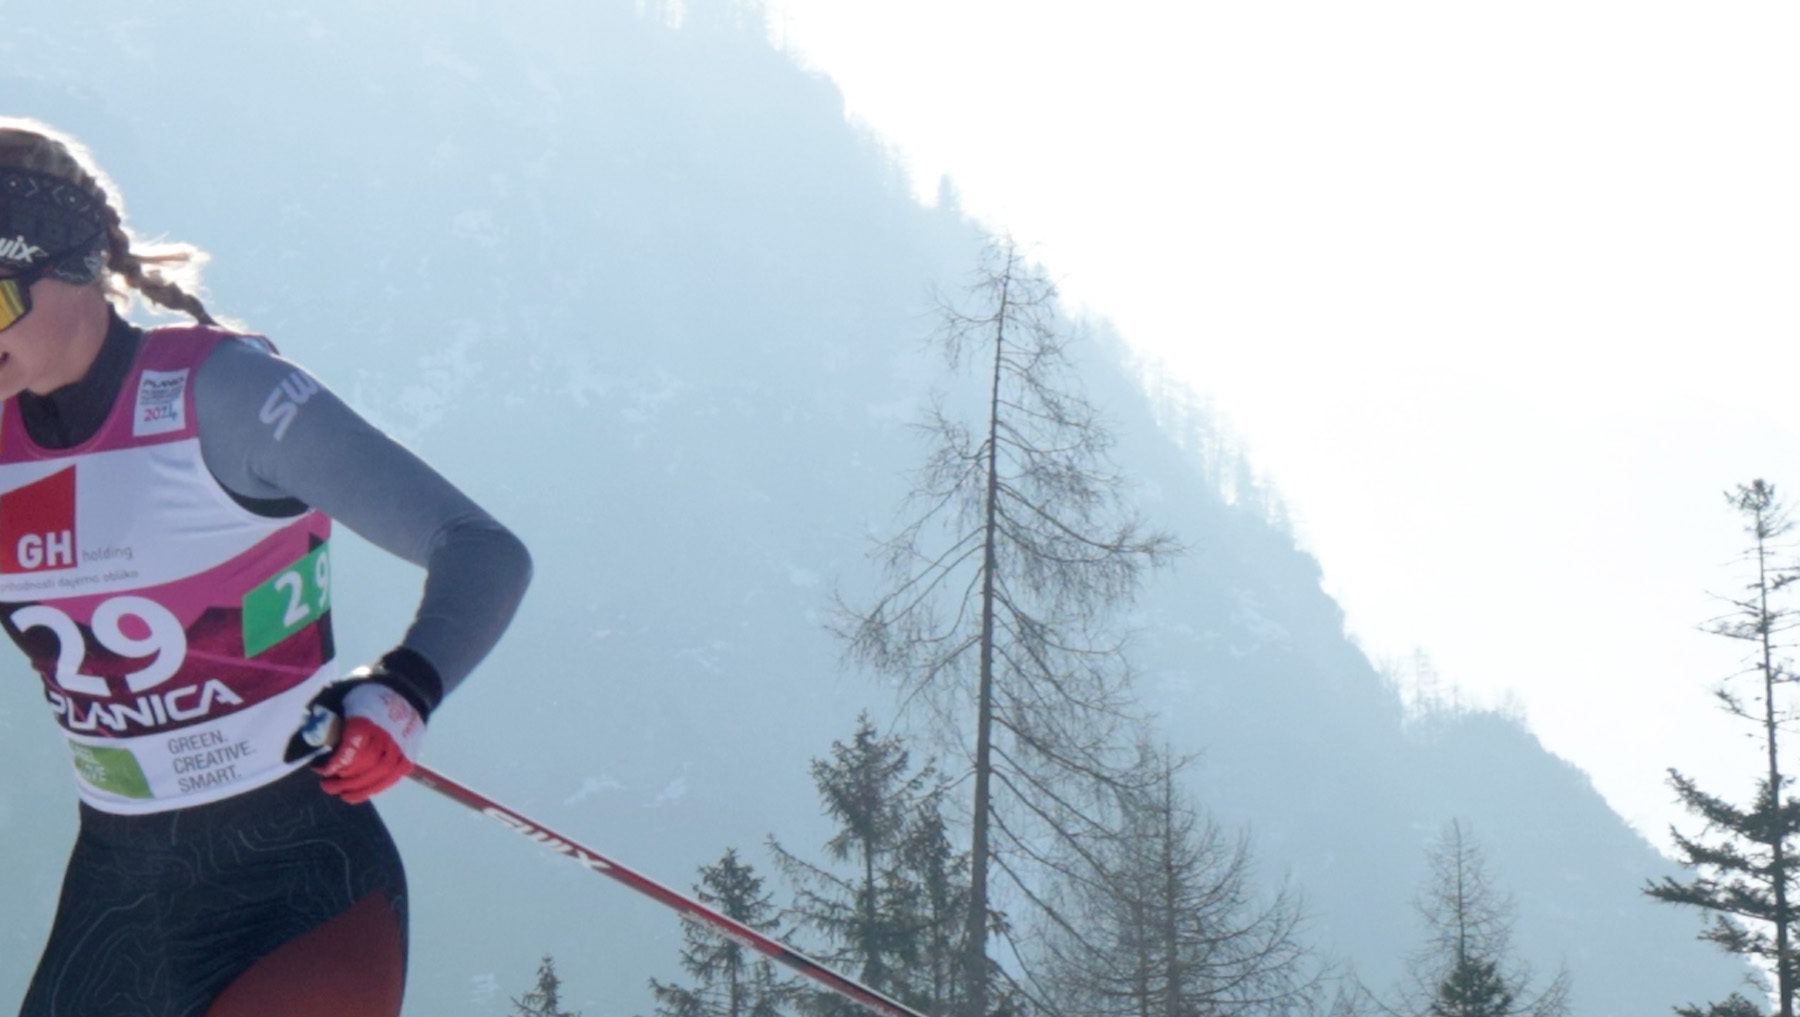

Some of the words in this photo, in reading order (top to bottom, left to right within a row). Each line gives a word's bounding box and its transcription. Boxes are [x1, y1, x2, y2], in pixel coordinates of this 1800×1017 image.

[17, 530, 72, 569] GH
[81, 546, 133, 560] holding
[274, 552, 329, 628] 29
[10, 596, 187, 696] 29
